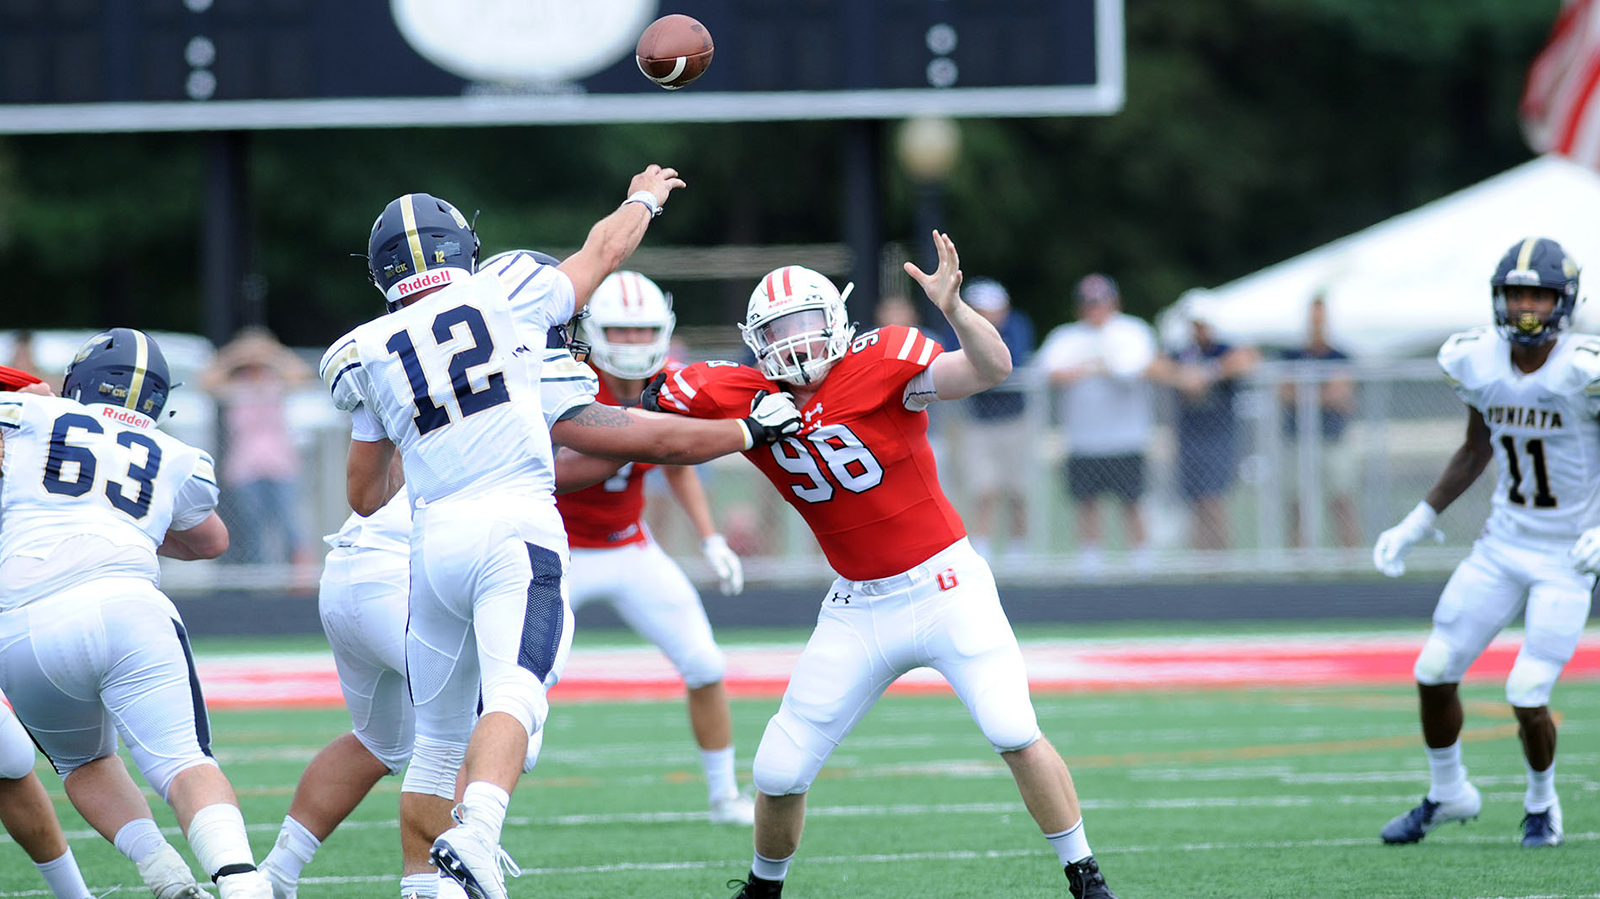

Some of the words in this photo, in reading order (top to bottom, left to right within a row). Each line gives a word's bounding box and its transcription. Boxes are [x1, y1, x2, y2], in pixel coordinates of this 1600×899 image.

[434, 250, 446, 264] 12
[397, 270, 451, 295] Riddell
[384, 303, 511, 436] 12
[102, 407, 150, 429] Riddell
[42, 411, 164, 521] 63
[769, 423, 885, 504] 98
[1499, 434, 1558, 509] 11
[935, 567, 960, 592] G
